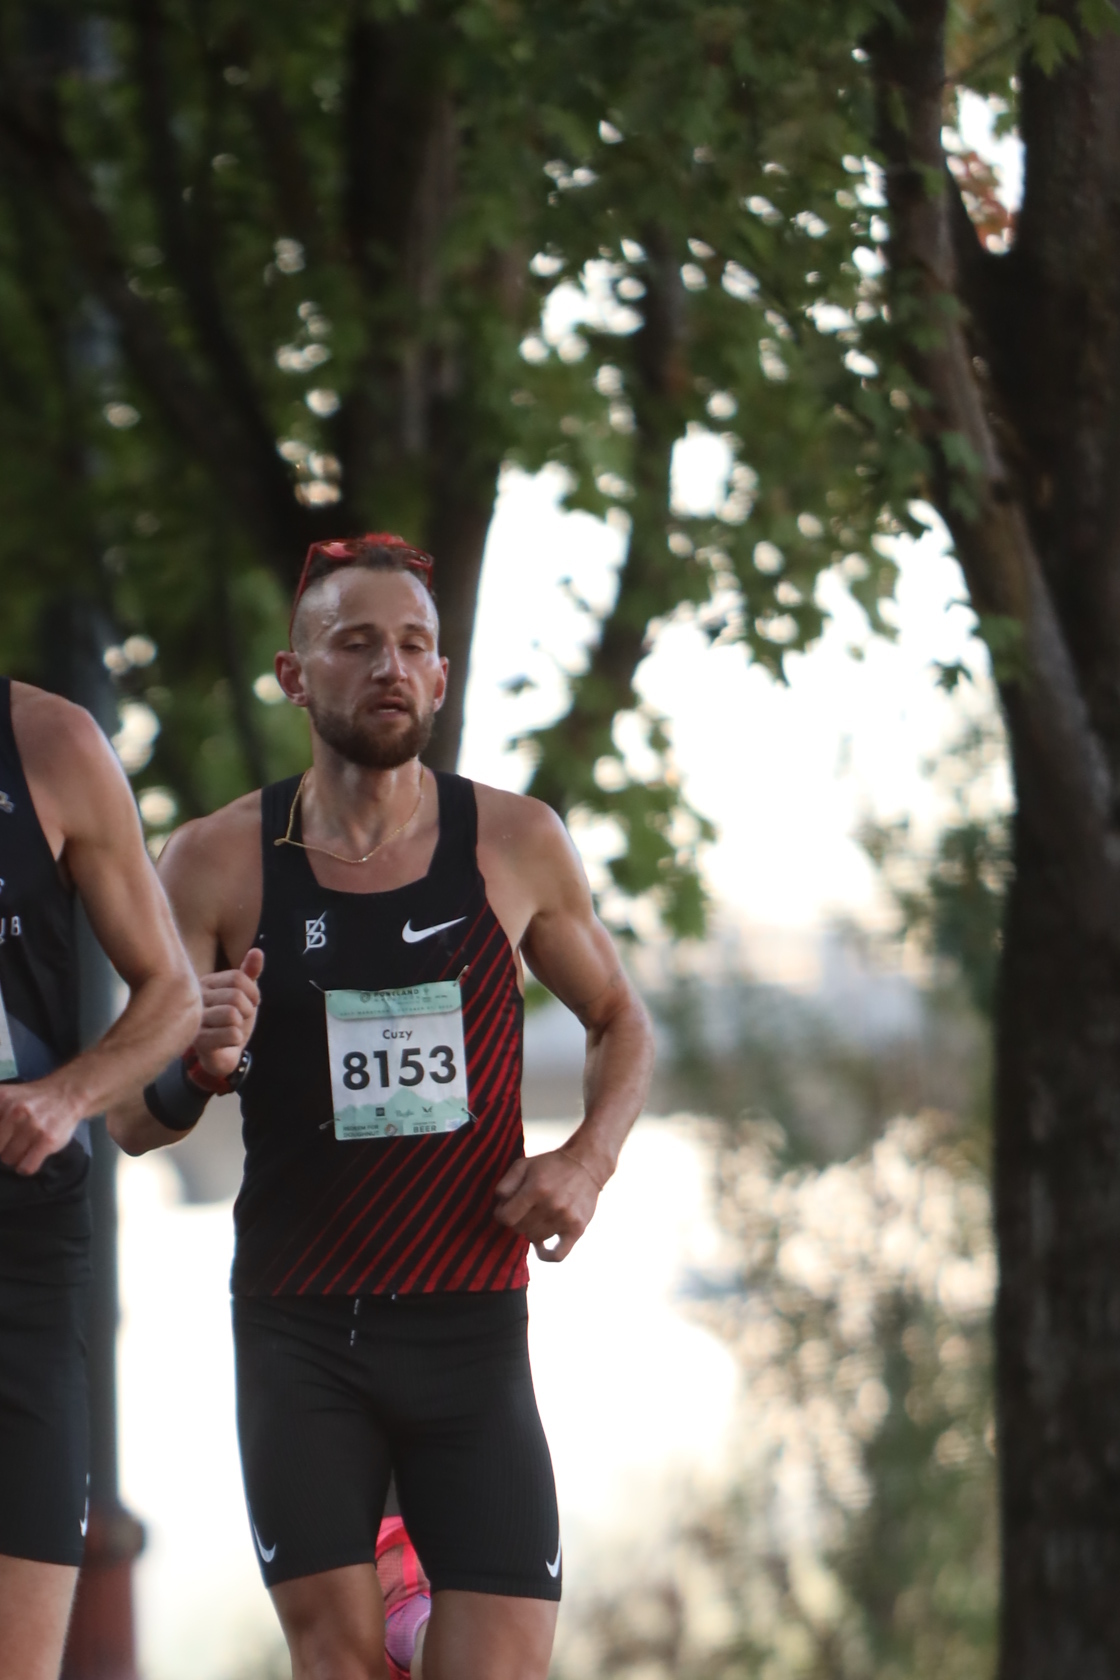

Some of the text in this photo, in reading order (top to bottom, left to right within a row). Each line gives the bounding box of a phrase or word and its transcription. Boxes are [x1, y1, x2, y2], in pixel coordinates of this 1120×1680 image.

[382, 1029, 413, 1041] Cuzy
[342, 1045, 457, 1090] 8153
[413, 1125, 437, 1133] BEER
